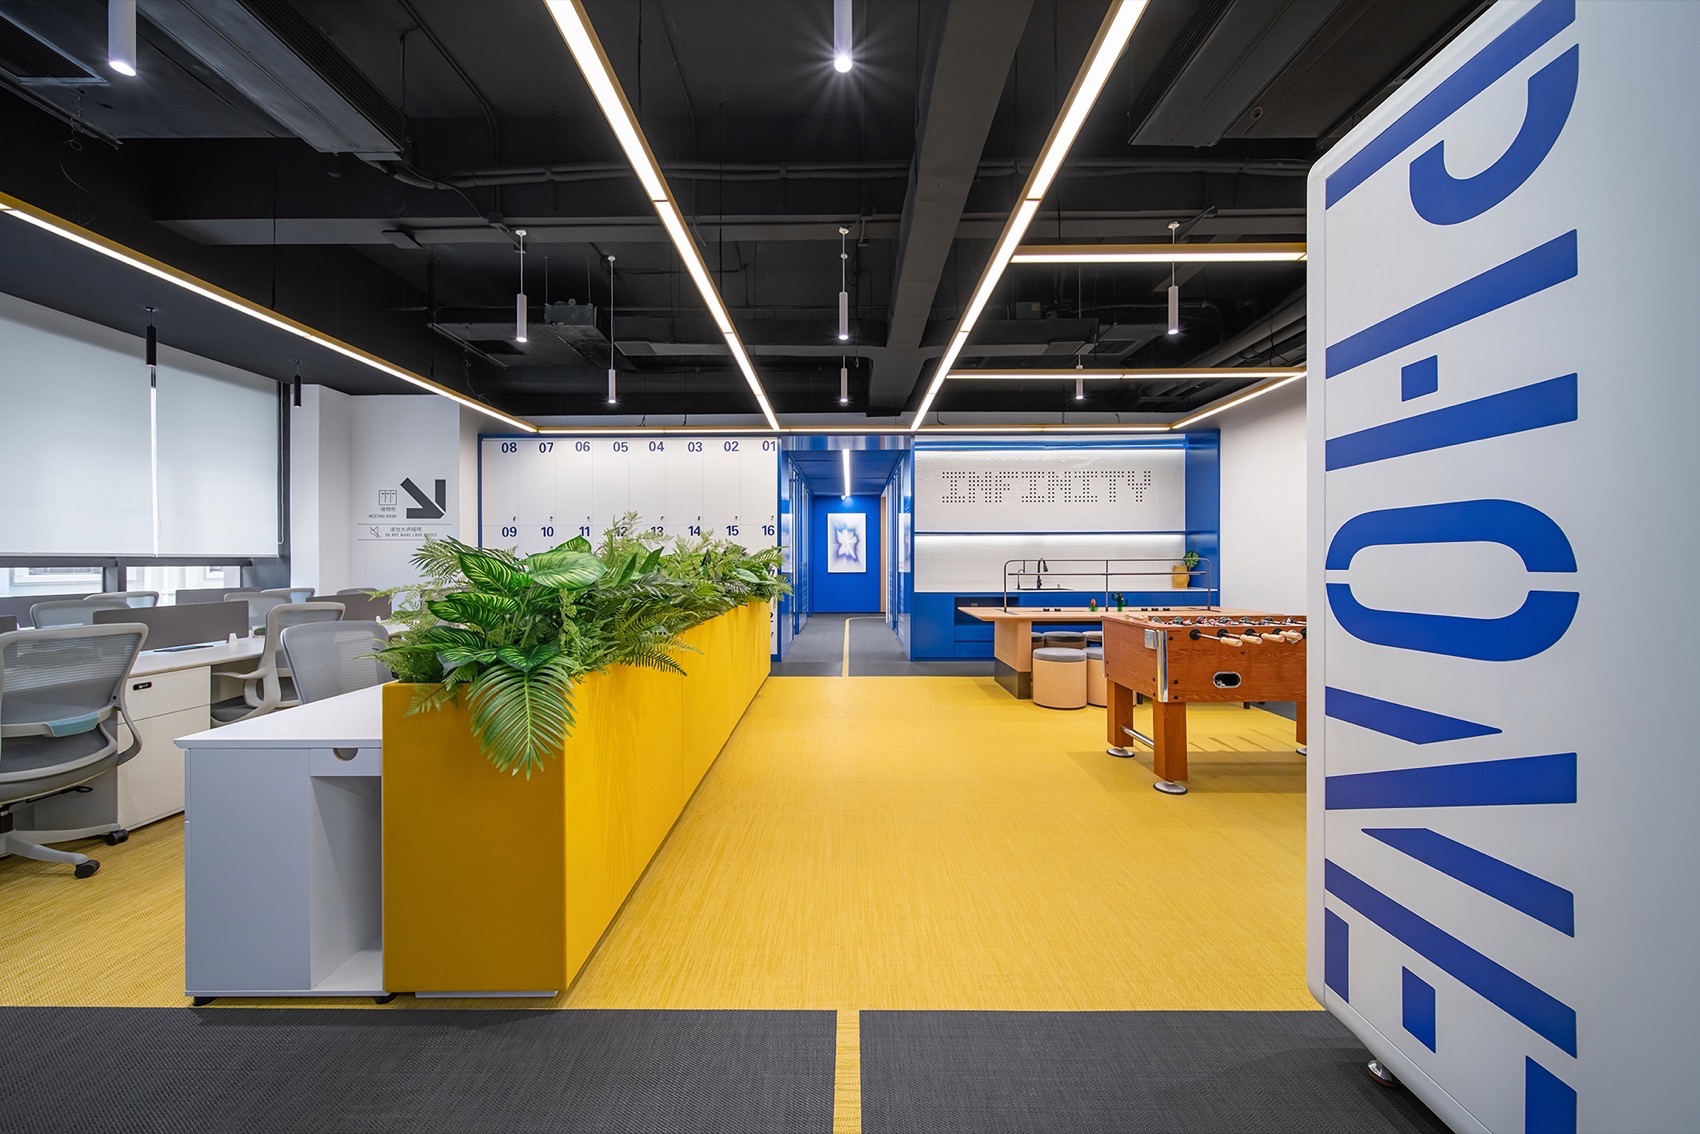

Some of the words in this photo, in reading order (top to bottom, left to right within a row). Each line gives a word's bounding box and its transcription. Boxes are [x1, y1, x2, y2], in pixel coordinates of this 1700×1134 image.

[501, 442, 518, 454] 08
[538, 442, 554, 454] 07
[575, 441, 591, 453] 06
[612, 441, 629, 453] 05
[648, 441, 665, 452] 04
[687, 441, 703, 453] 03
[723, 441, 739, 452] 02
[762, 440, 776, 452] 01
[941, 470, 1151, 503] INFINITY
[501, 526, 518, 538] 09
[540, 526, 555, 538] 10
[579, 526, 591, 537] 11
[650, 525, 665, 537] 13
[688, 525, 701, 537] 14
[725, 525, 740, 537] 15
[761, 525, 776, 536] 16
[1325, 0, 1579, 1134] PHONE
